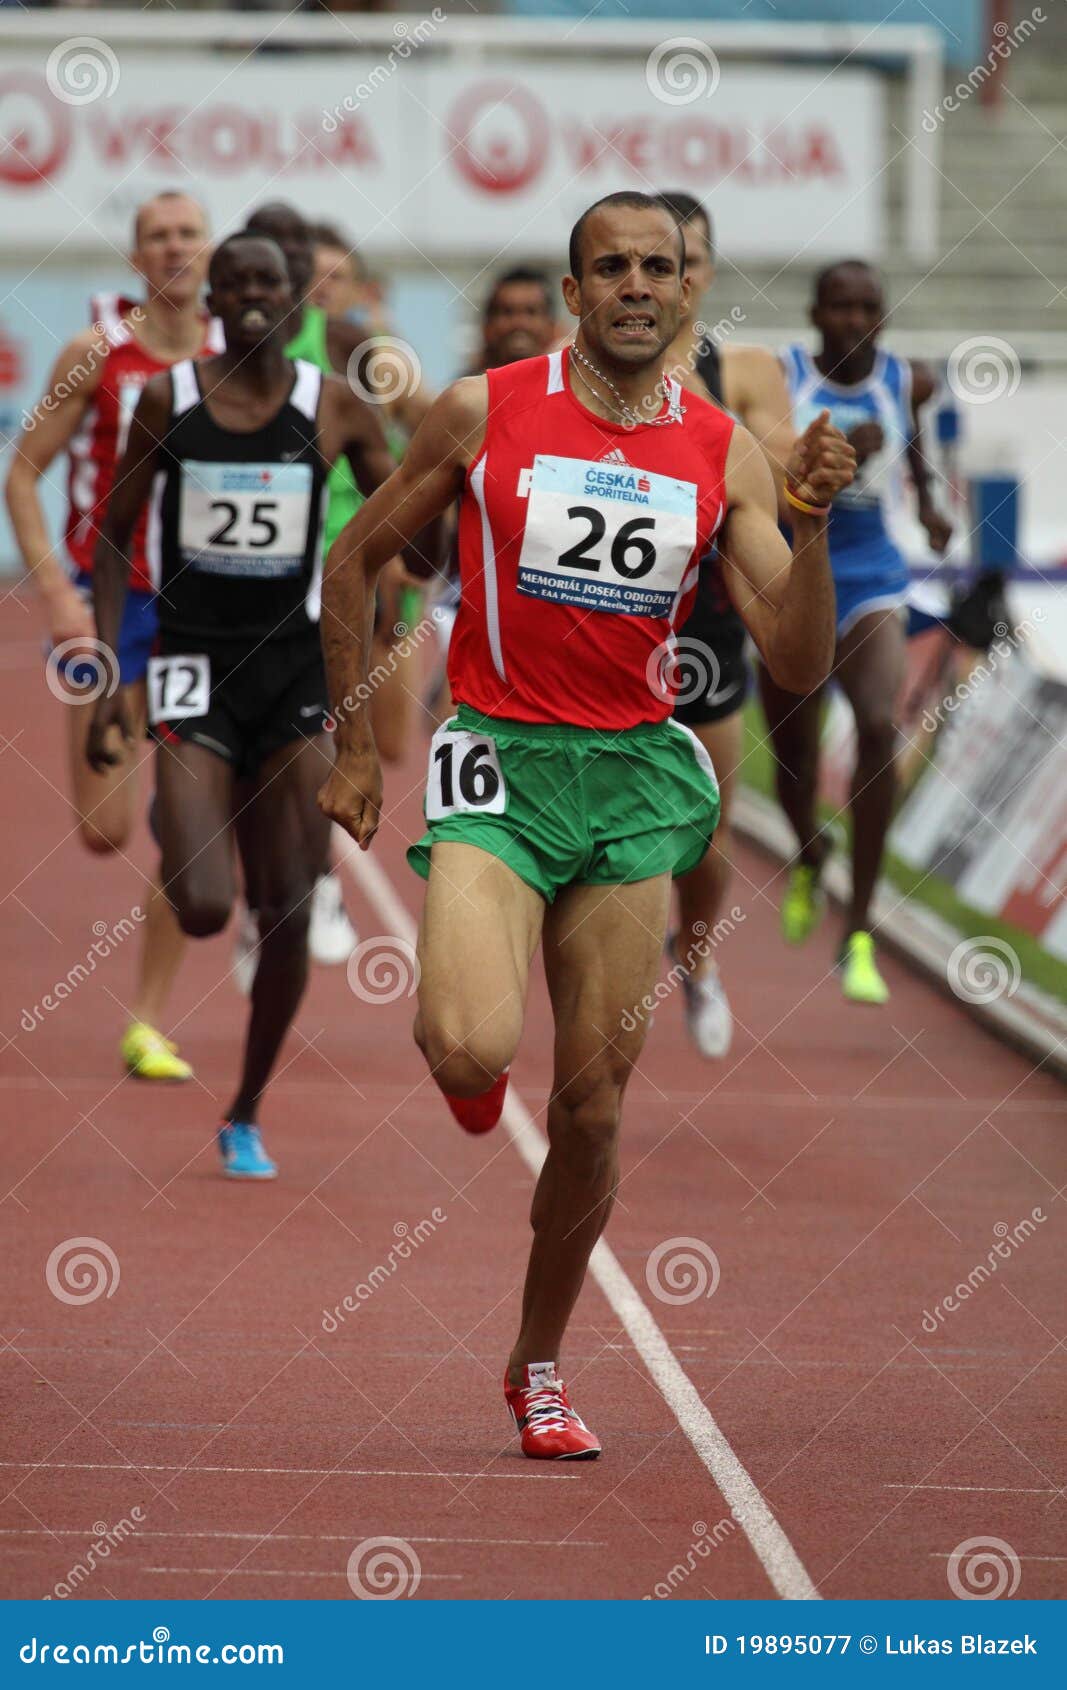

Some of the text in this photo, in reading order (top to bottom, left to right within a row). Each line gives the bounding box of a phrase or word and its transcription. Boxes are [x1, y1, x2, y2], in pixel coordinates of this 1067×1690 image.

[88, 105, 382, 175] VEOLIA
[564, 112, 844, 182] VEOLIA
[584, 484, 649, 504] SPOŘITELNA
[585, 467, 636, 490] ČESKÁ
[208, 502, 279, 547] 25
[557, 506, 657, 579] 26
[520, 571, 671, 605] MEMORIÁL JOSEFA ODLOŽILA
[541, 589, 652, 613] EAA Premium Meeting 2011
[157, 666, 200, 708] 12
[435, 743, 500, 807] 16
